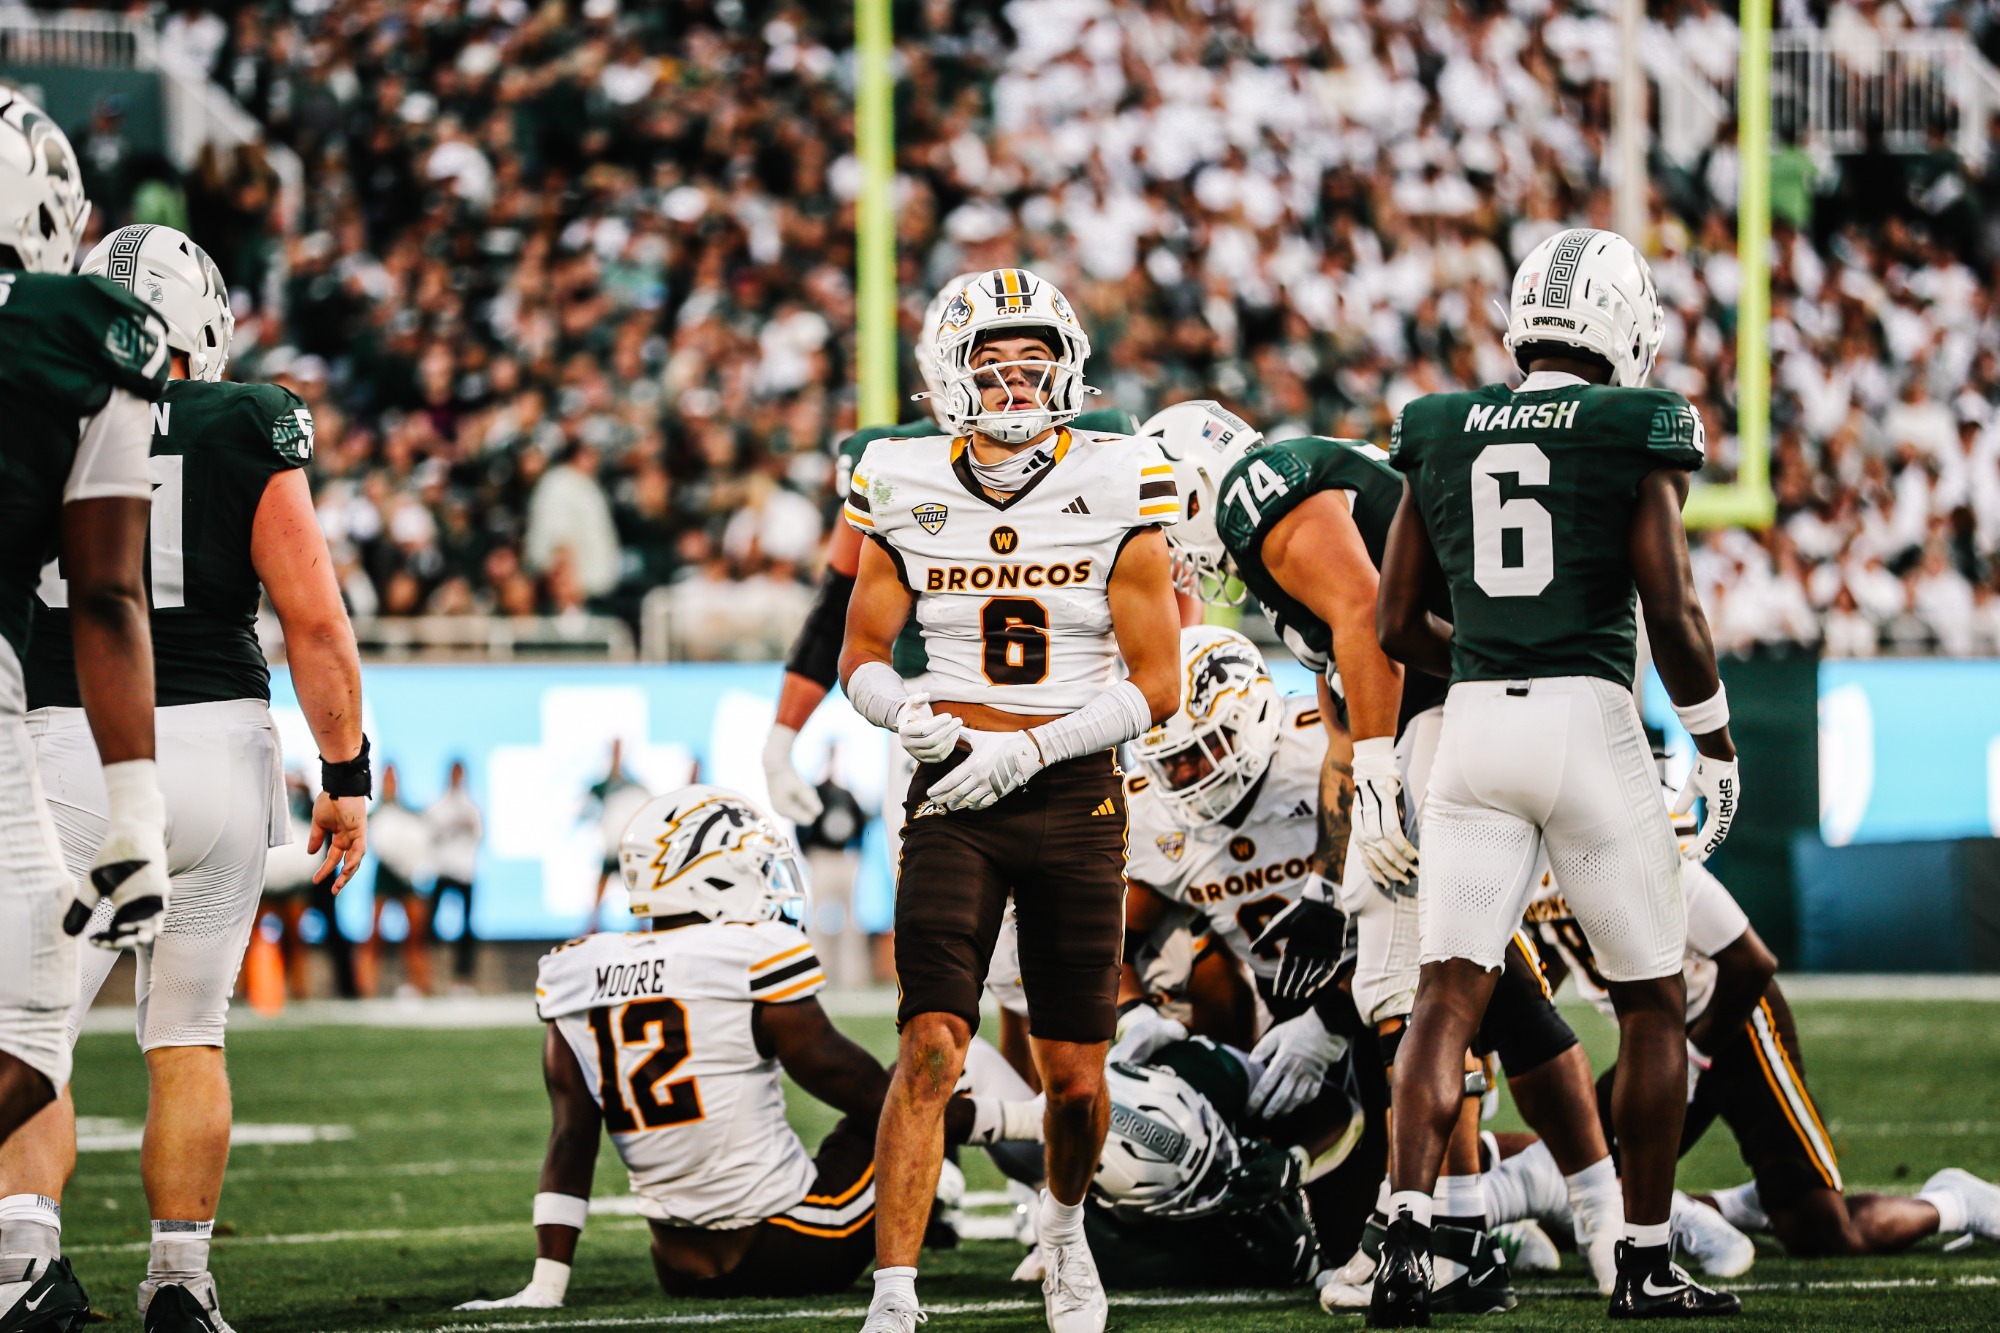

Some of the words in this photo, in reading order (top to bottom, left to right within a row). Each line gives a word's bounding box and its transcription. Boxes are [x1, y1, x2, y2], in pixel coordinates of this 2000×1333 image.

[997, 306, 1031, 315] GRIT
[1532, 316, 1576, 329] SPARTANS
[1463, 400, 1580, 432] MARSH
[1223, 459, 1289, 528] 74
[916, 511, 947, 523] MAC
[1471, 442, 1554, 598] 6
[994, 532, 1014, 549] W
[926, 559, 1092, 593] BRONCOS
[978, 595, 1050, 686] 6
[1704, 778, 1733, 854] SPARTANS
[591, 959, 665, 1001] MOORE
[588, 998, 706, 1133] 12
